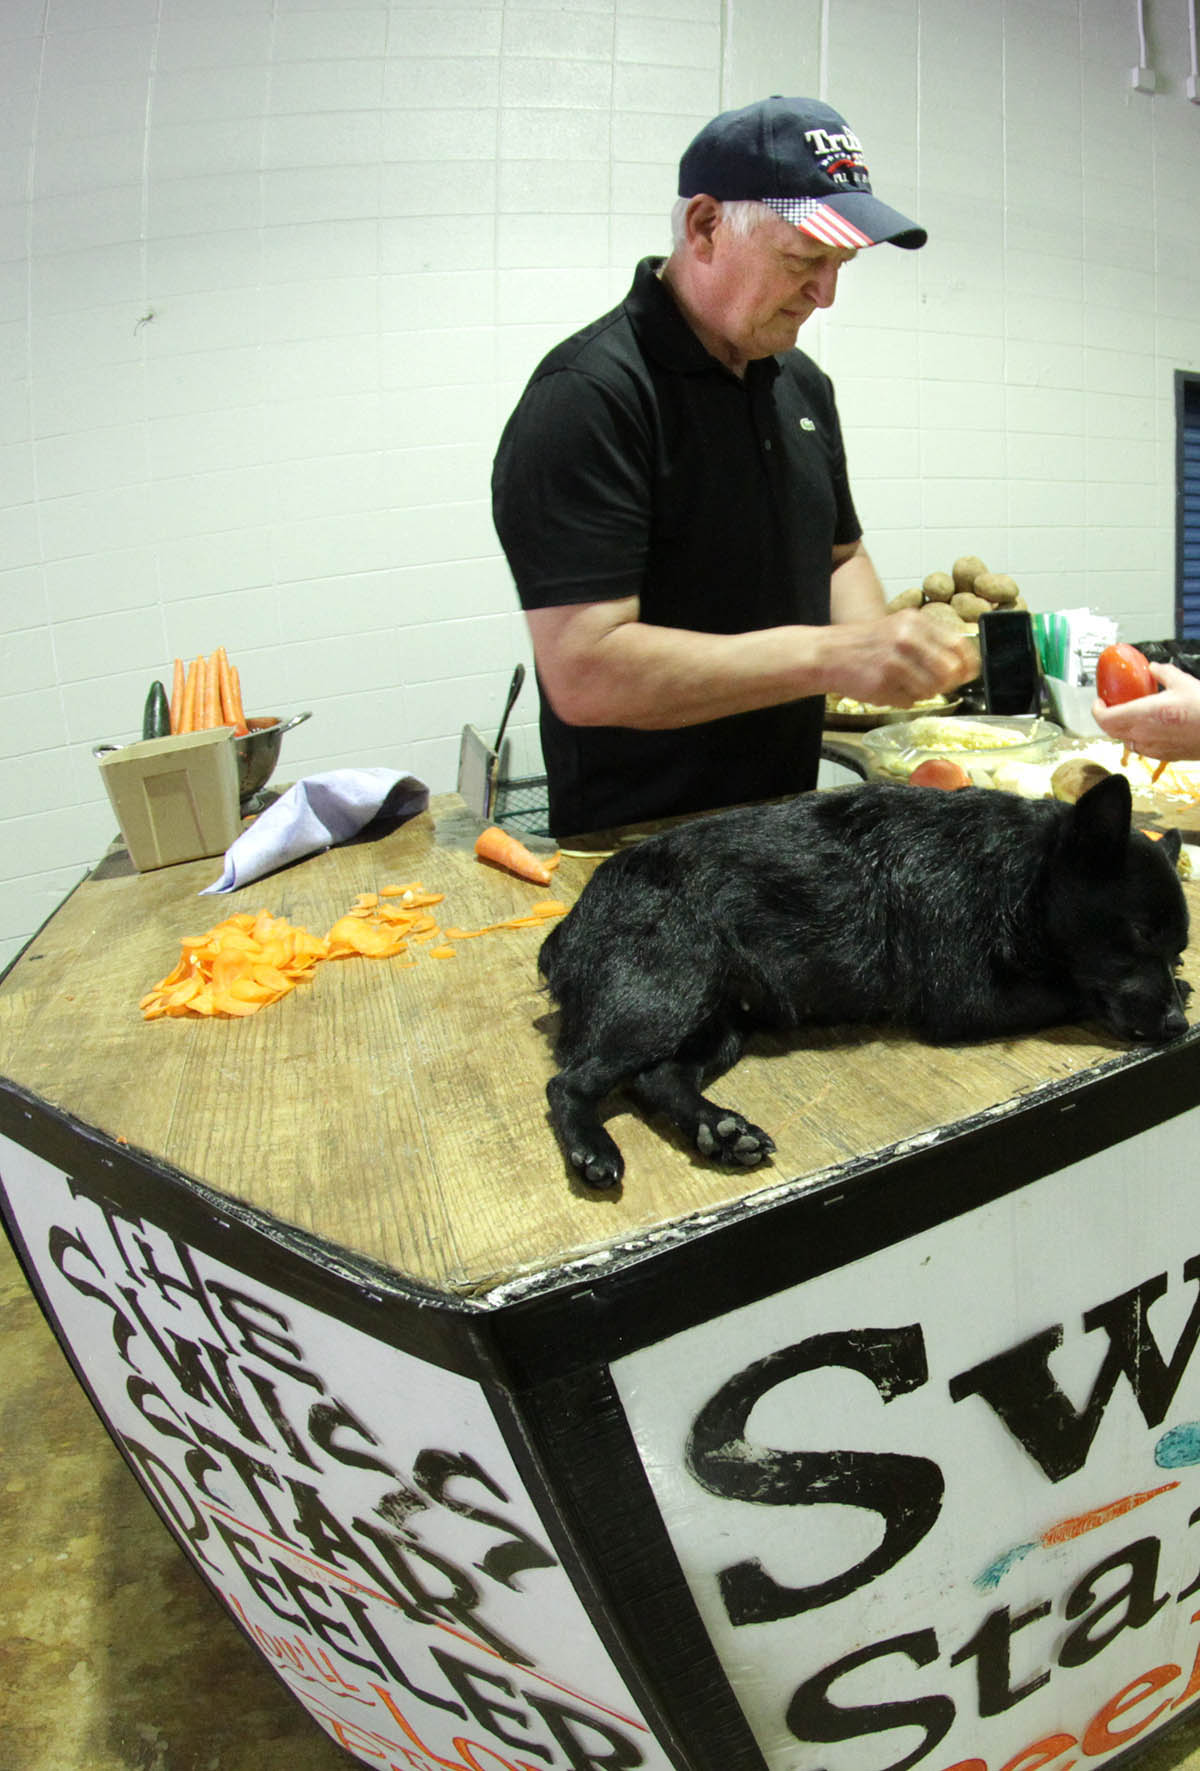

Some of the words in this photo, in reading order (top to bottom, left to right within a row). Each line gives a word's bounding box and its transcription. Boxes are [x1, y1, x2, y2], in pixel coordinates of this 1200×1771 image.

[804, 125, 863, 155] Tru
[48, 1225, 558, 1593] SWISS
[67, 1177, 326, 1396] THE
[126, 1375, 536, 1668] STAR
